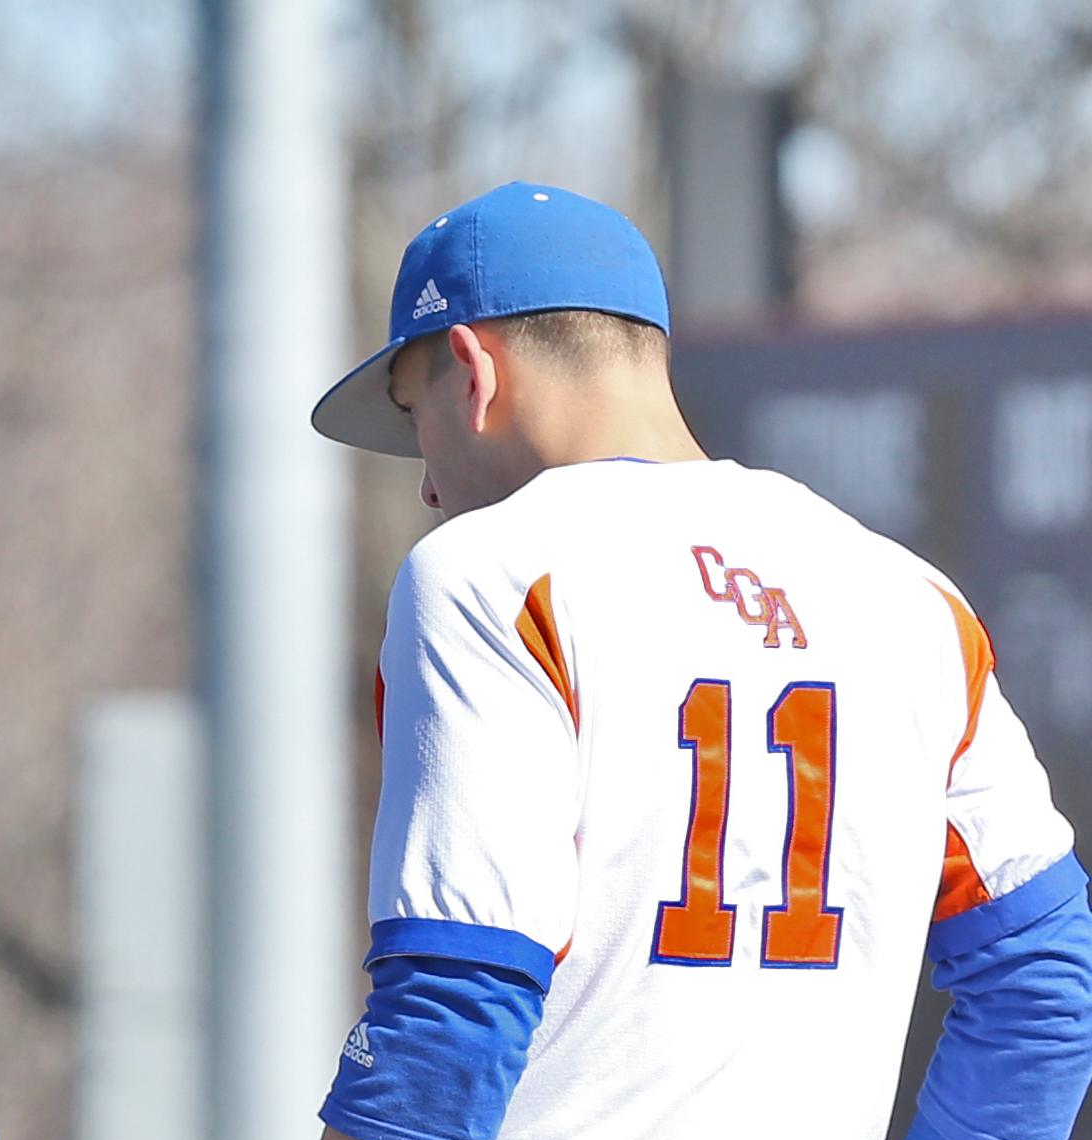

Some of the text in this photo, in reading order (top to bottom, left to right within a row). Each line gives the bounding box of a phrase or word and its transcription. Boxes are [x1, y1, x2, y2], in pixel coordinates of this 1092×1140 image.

[412, 298, 448, 320] adidas
[691, 545, 808, 649] CGA
[649, 678, 844, 970] 11
